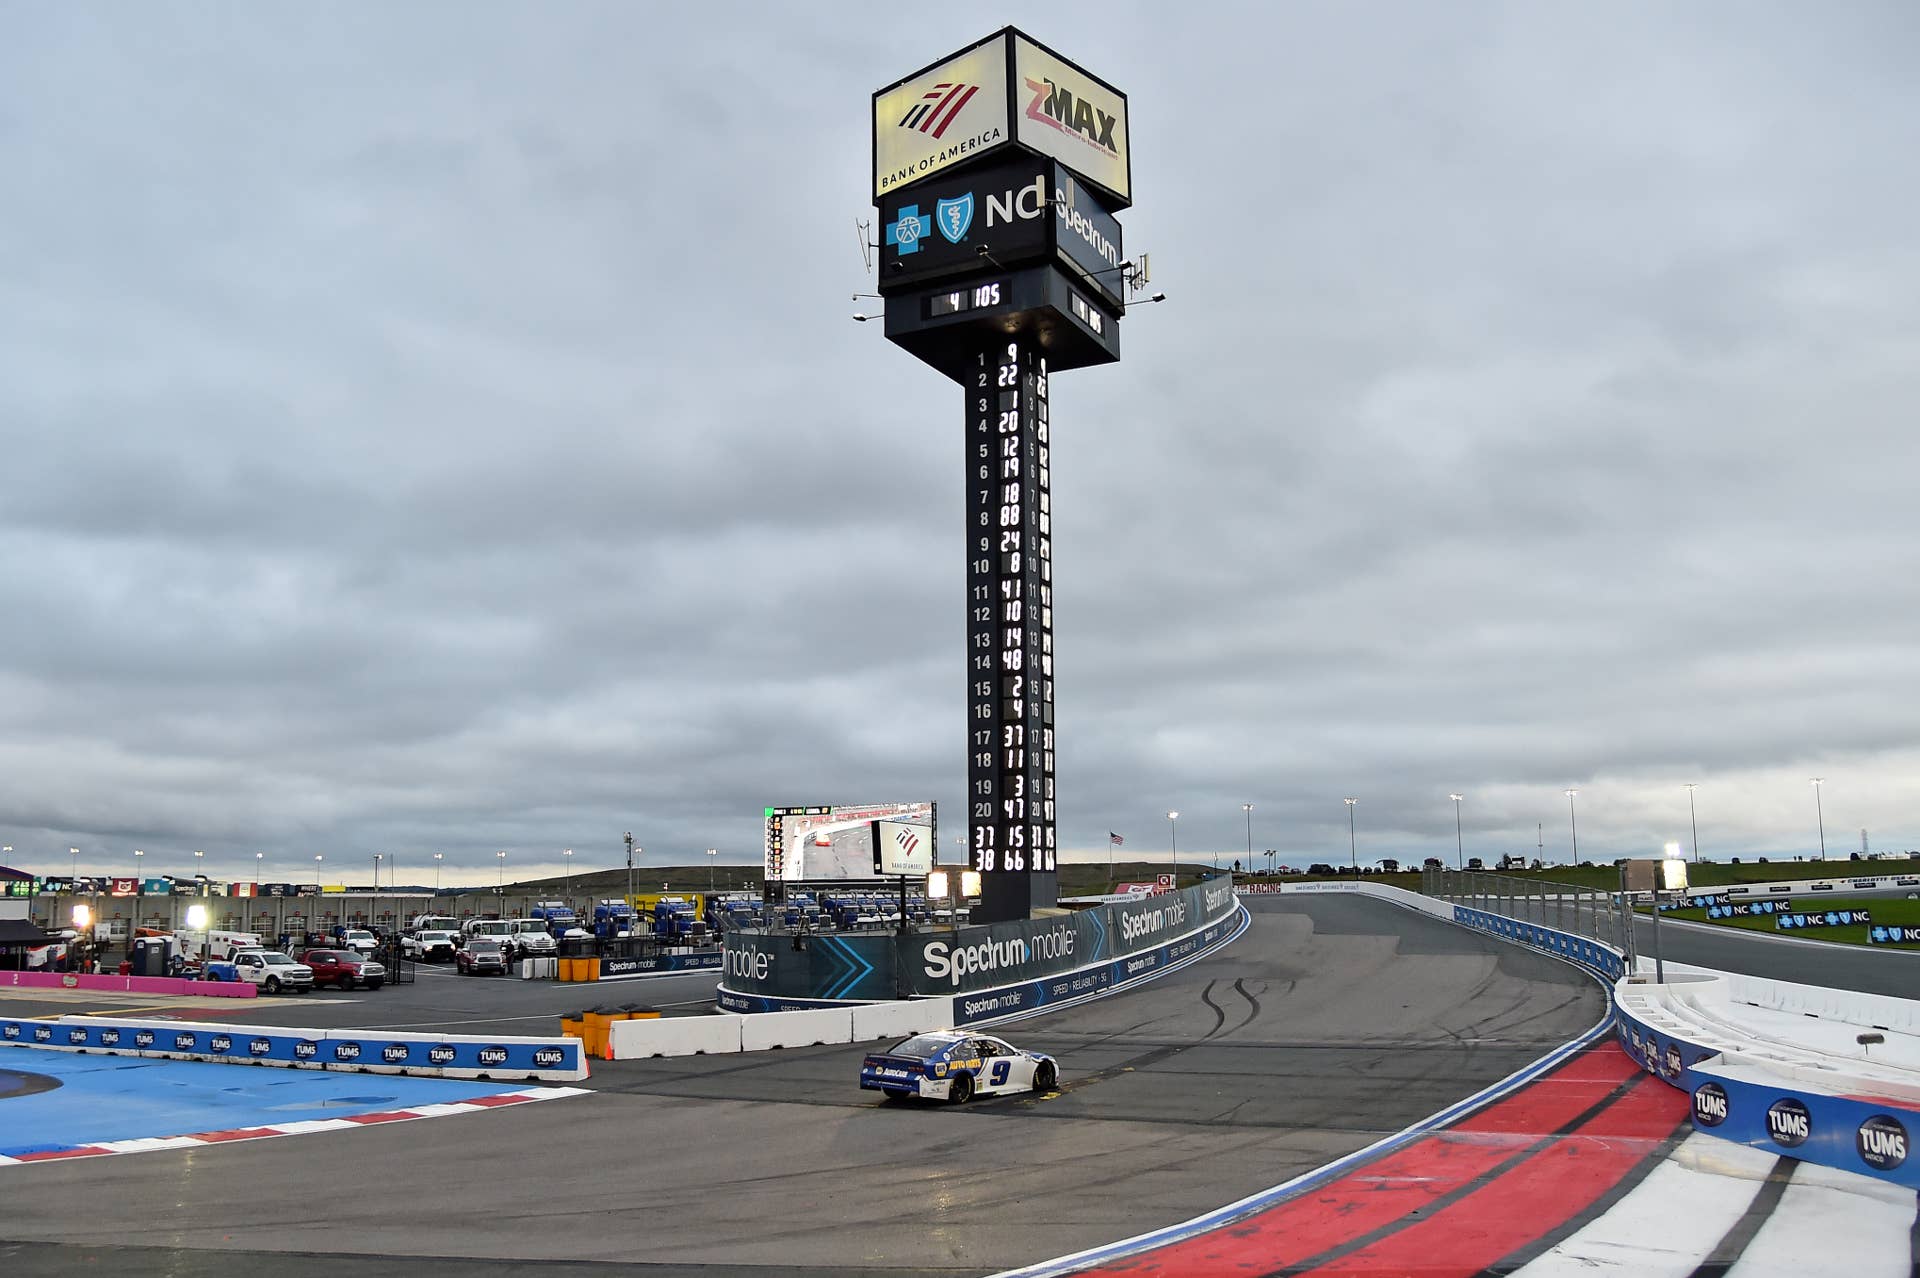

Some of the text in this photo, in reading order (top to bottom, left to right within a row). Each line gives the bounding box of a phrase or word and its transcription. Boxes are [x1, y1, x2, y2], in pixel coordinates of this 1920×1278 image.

[882, 127, 1000, 188] BANK OF AMERICA
[986, 184, 1041, 227] NC
[950, 283, 1000, 311] 4 105
[978, 343, 1017, 366] 1 9
[979, 364, 1018, 387] 2 22
[1029, 372, 1034, 386] 2
[979, 390, 1018, 412] 3 1
[978, 410, 1018, 433] 4 20
[1030, 419, 1034, 432] 4
[980, 436, 1019, 458] 5 12
[1030, 442, 1035, 456] 5
[980, 457, 1020, 479] 6 19
[1030, 464, 1036, 478] 6
[980, 482, 1020, 504] 7 18
[1031, 489, 1036, 503] 7
[980, 504, 1020, 526] 8 88
[981, 531, 1020, 552] 9 24
[973, 559, 989, 574] 10
[1011, 552, 1020, 573] 8
[1029, 557, 1038, 572] 10
[974, 579, 1020, 600] 11 41
[1029, 582, 1038, 598] 11
[974, 600, 1022, 621] 12 10
[1029, 605, 1038, 620] 12
[974, 628, 1022, 648] 13 14
[1030, 632, 1038, 646] 13
[974, 649, 1022, 670] 14 48
[1030, 653, 1038, 669] 14
[974, 676, 1022, 697] 15 2
[1030, 680, 1052, 701] 15 2
[974, 699, 1022, 718] 16 4
[1030, 702, 1039, 717] 16
[974, 725, 1023, 748] 17 37
[1031, 728, 1040, 744] 17
[976, 749, 1023, 768] 18 11
[1032, 752, 1040, 767] 18
[976, 775, 1024, 797] 19 3
[1032, 778, 1054, 799] 19 3
[976, 798, 1024, 819] 20 47
[1032, 802, 1040, 817] 20
[976, 826, 1024, 848] 37 15
[976, 849, 1024, 871] 38 66
[1250, 882, 1281, 894] RACING
[1680, 899, 1693, 907] NC
[1716, 894, 1730, 904] NC
[1775, 901, 1790, 911] NC
[1734, 905, 1748, 915] NC
[1853, 911, 1870, 922] NC
[1122, 907, 1163, 945] Spectrum
[1807, 914, 1824, 925] NC
[1904, 928, 1920, 939] NC
[609, 961, 636, 973] Spectrum
[923, 936, 1025, 986] Spectrum
[965, 997, 998, 1017] Spectrum
[1053, 983, 1069, 996] SPEED
[1072, 975, 1097, 991] RELIABILITY
[5, 1026, 20, 1036] TUMS
[36, 1029, 50, 1039] TUMS
[70, 1031, 86, 1041] TUMS
[102, 1033, 118, 1042] TUMS
[136, 1035, 153, 1044] TUMS
[177, 1037, 194, 1046] TUMS
[212, 1039, 230, 1049] TUMS
[251, 1042, 269, 1052] TUMS
[296, 1045, 316, 1055] TUMS
[337, 1047, 359, 1057] TUMS
[384, 1048, 407, 1059] TUMS
[430, 1050, 454, 1060] TUMS
[480, 1051, 506, 1062] TUMS
[536, 1052, 562, 1063] TUMS
[949, 1060, 965, 1070] AUTO
[989, 1061, 1011, 1086] 9
[1696, 1092, 1727, 1118] TUMS
[1769, 1110, 1808, 1138] TUMS
[1860, 1128, 1906, 1159] TUMS
